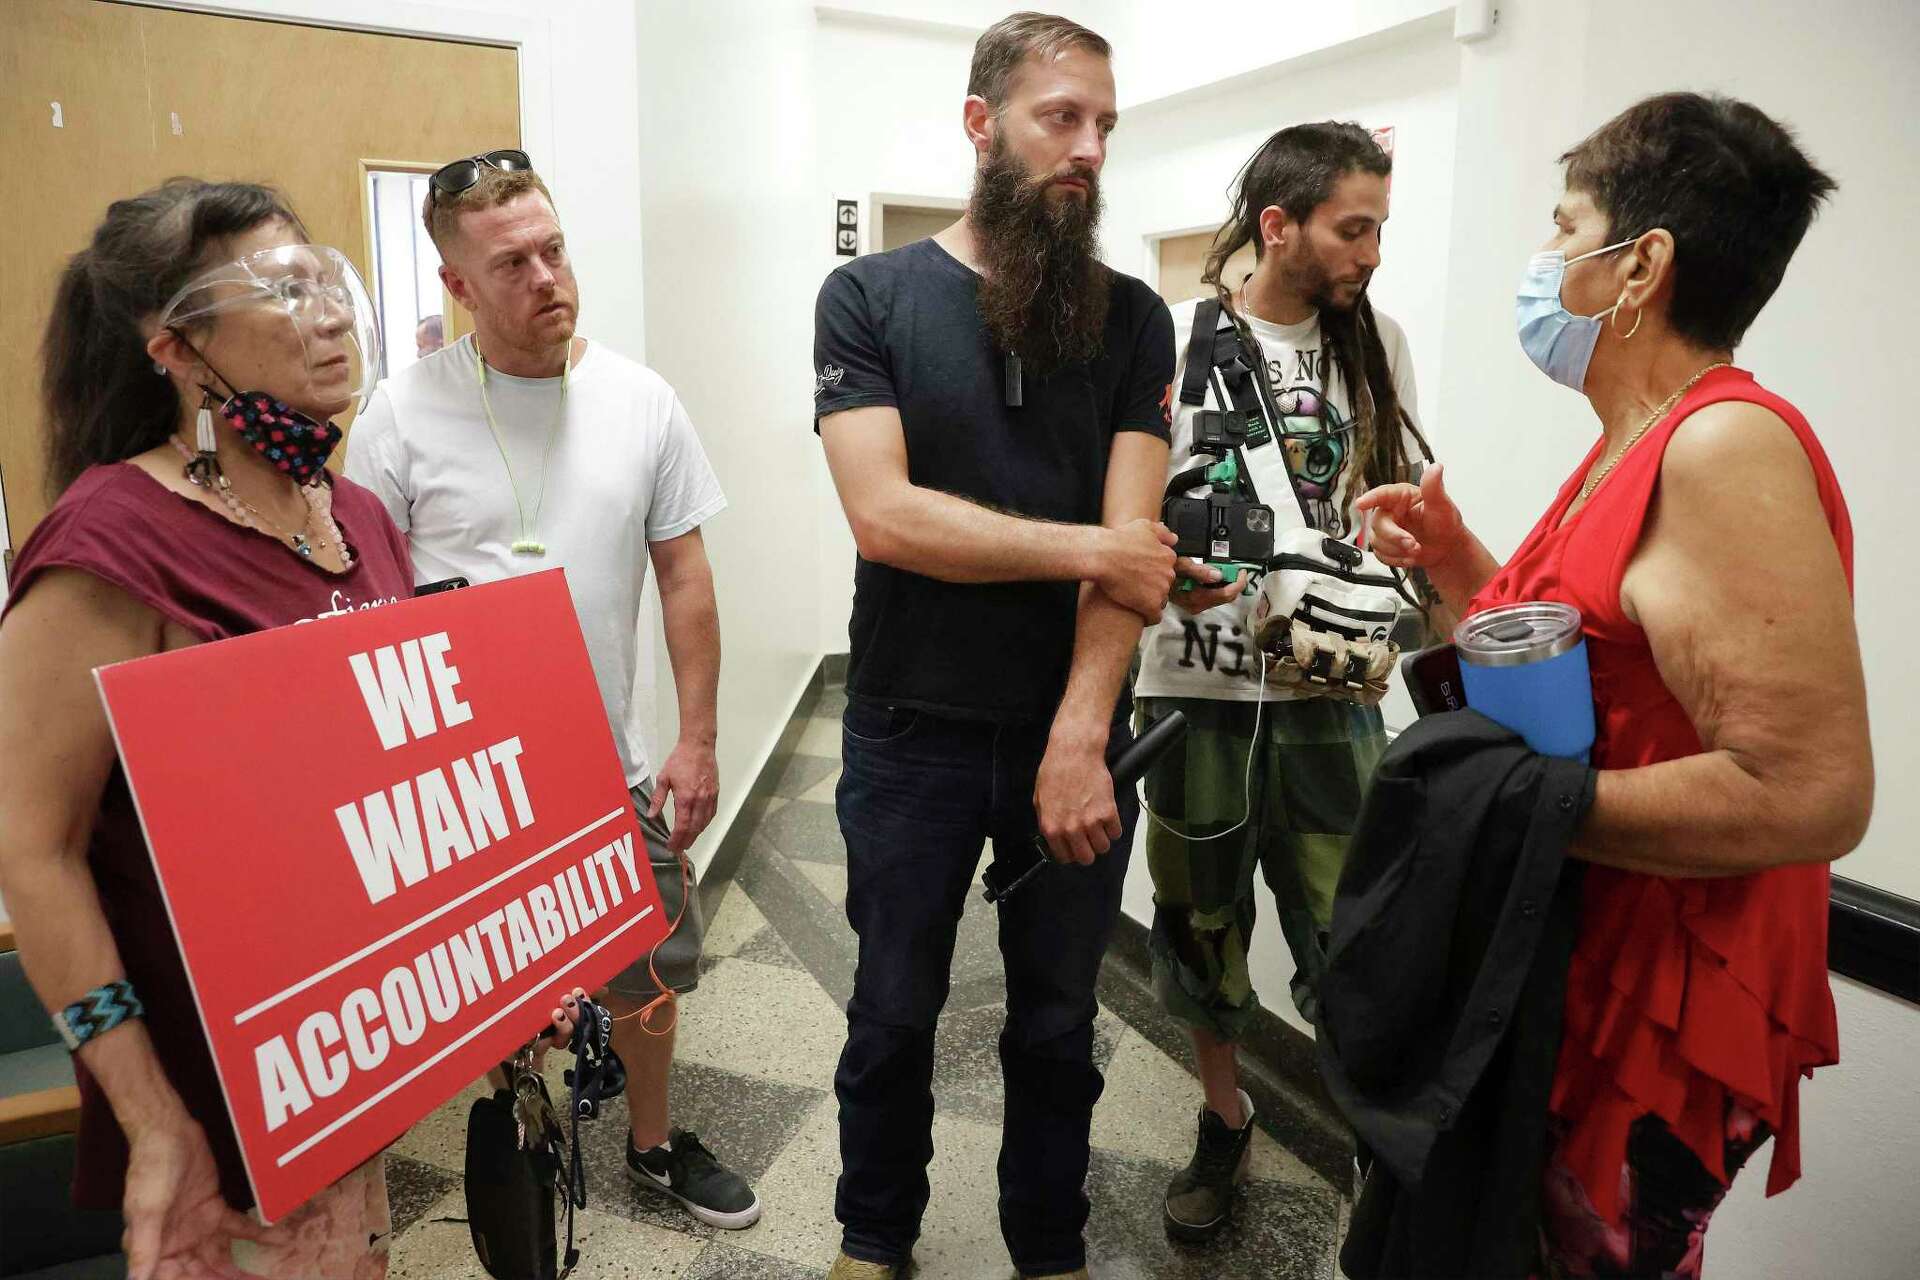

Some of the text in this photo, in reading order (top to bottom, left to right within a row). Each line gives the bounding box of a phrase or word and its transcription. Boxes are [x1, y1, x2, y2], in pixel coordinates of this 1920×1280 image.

[348, 631, 474, 751] WE
[334, 735, 535, 905] WANT
[255, 832, 642, 1132] ACCOUNTABILITY
